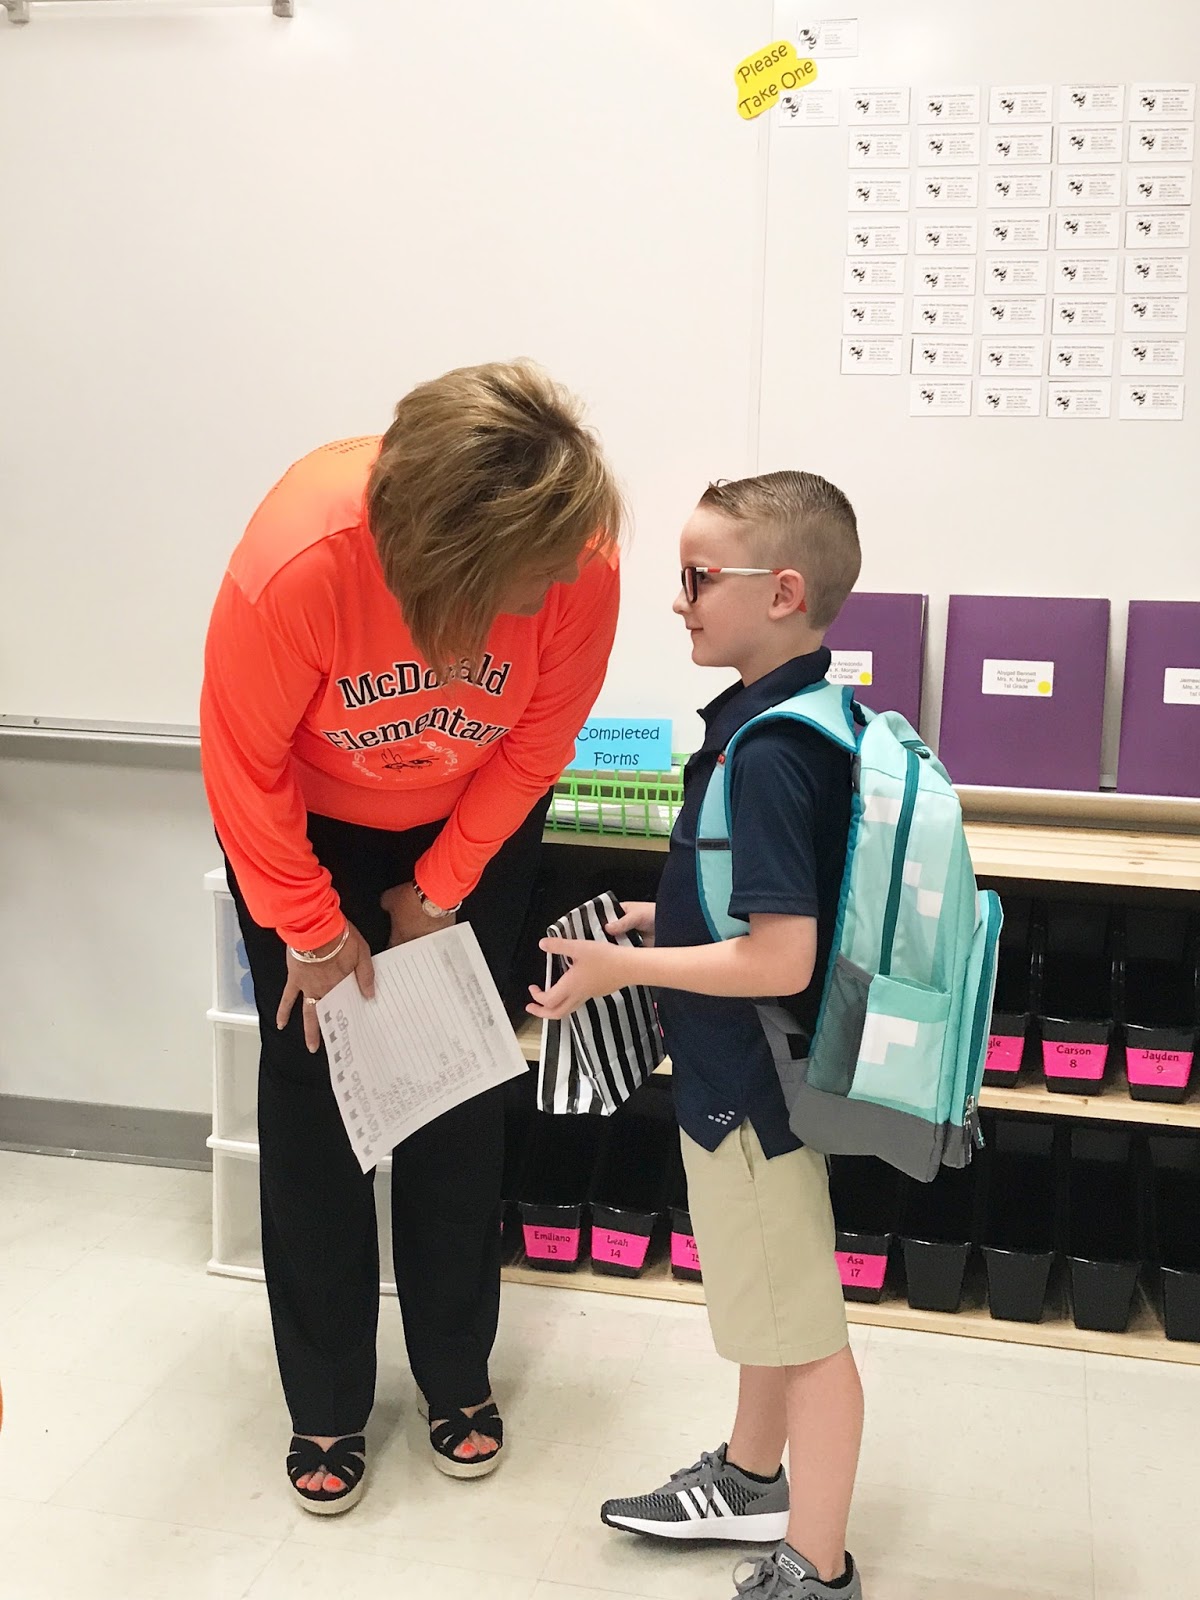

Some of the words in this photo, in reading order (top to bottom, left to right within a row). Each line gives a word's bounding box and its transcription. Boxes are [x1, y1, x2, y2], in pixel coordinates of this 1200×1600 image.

[738, 45, 788, 83] Please
[739, 84, 778, 115] Take
[781, 61, 814, 89] One
[320, 705, 511, 753] Elementary
[577, 726, 660, 741] Completed
[594, 752, 640, 766] Forms
[1056, 1044, 1091, 1055] Carson
[1142, 1051, 1179, 1063] Jayden
[1070, 1059, 1077, 1068] 8
[1156, 1065, 1164, 1074] 9
[534, 1231, 571, 1242] Emiliano
[607, 1235, 629, 1247] Leah
[547, 1245, 558, 1253] 13
[685, 1239, 698, 1249] Ka
[610, 1249, 621, 1258] 14
[847, 1255, 864, 1265] Asa
[850, 1269, 861, 1277] 17
